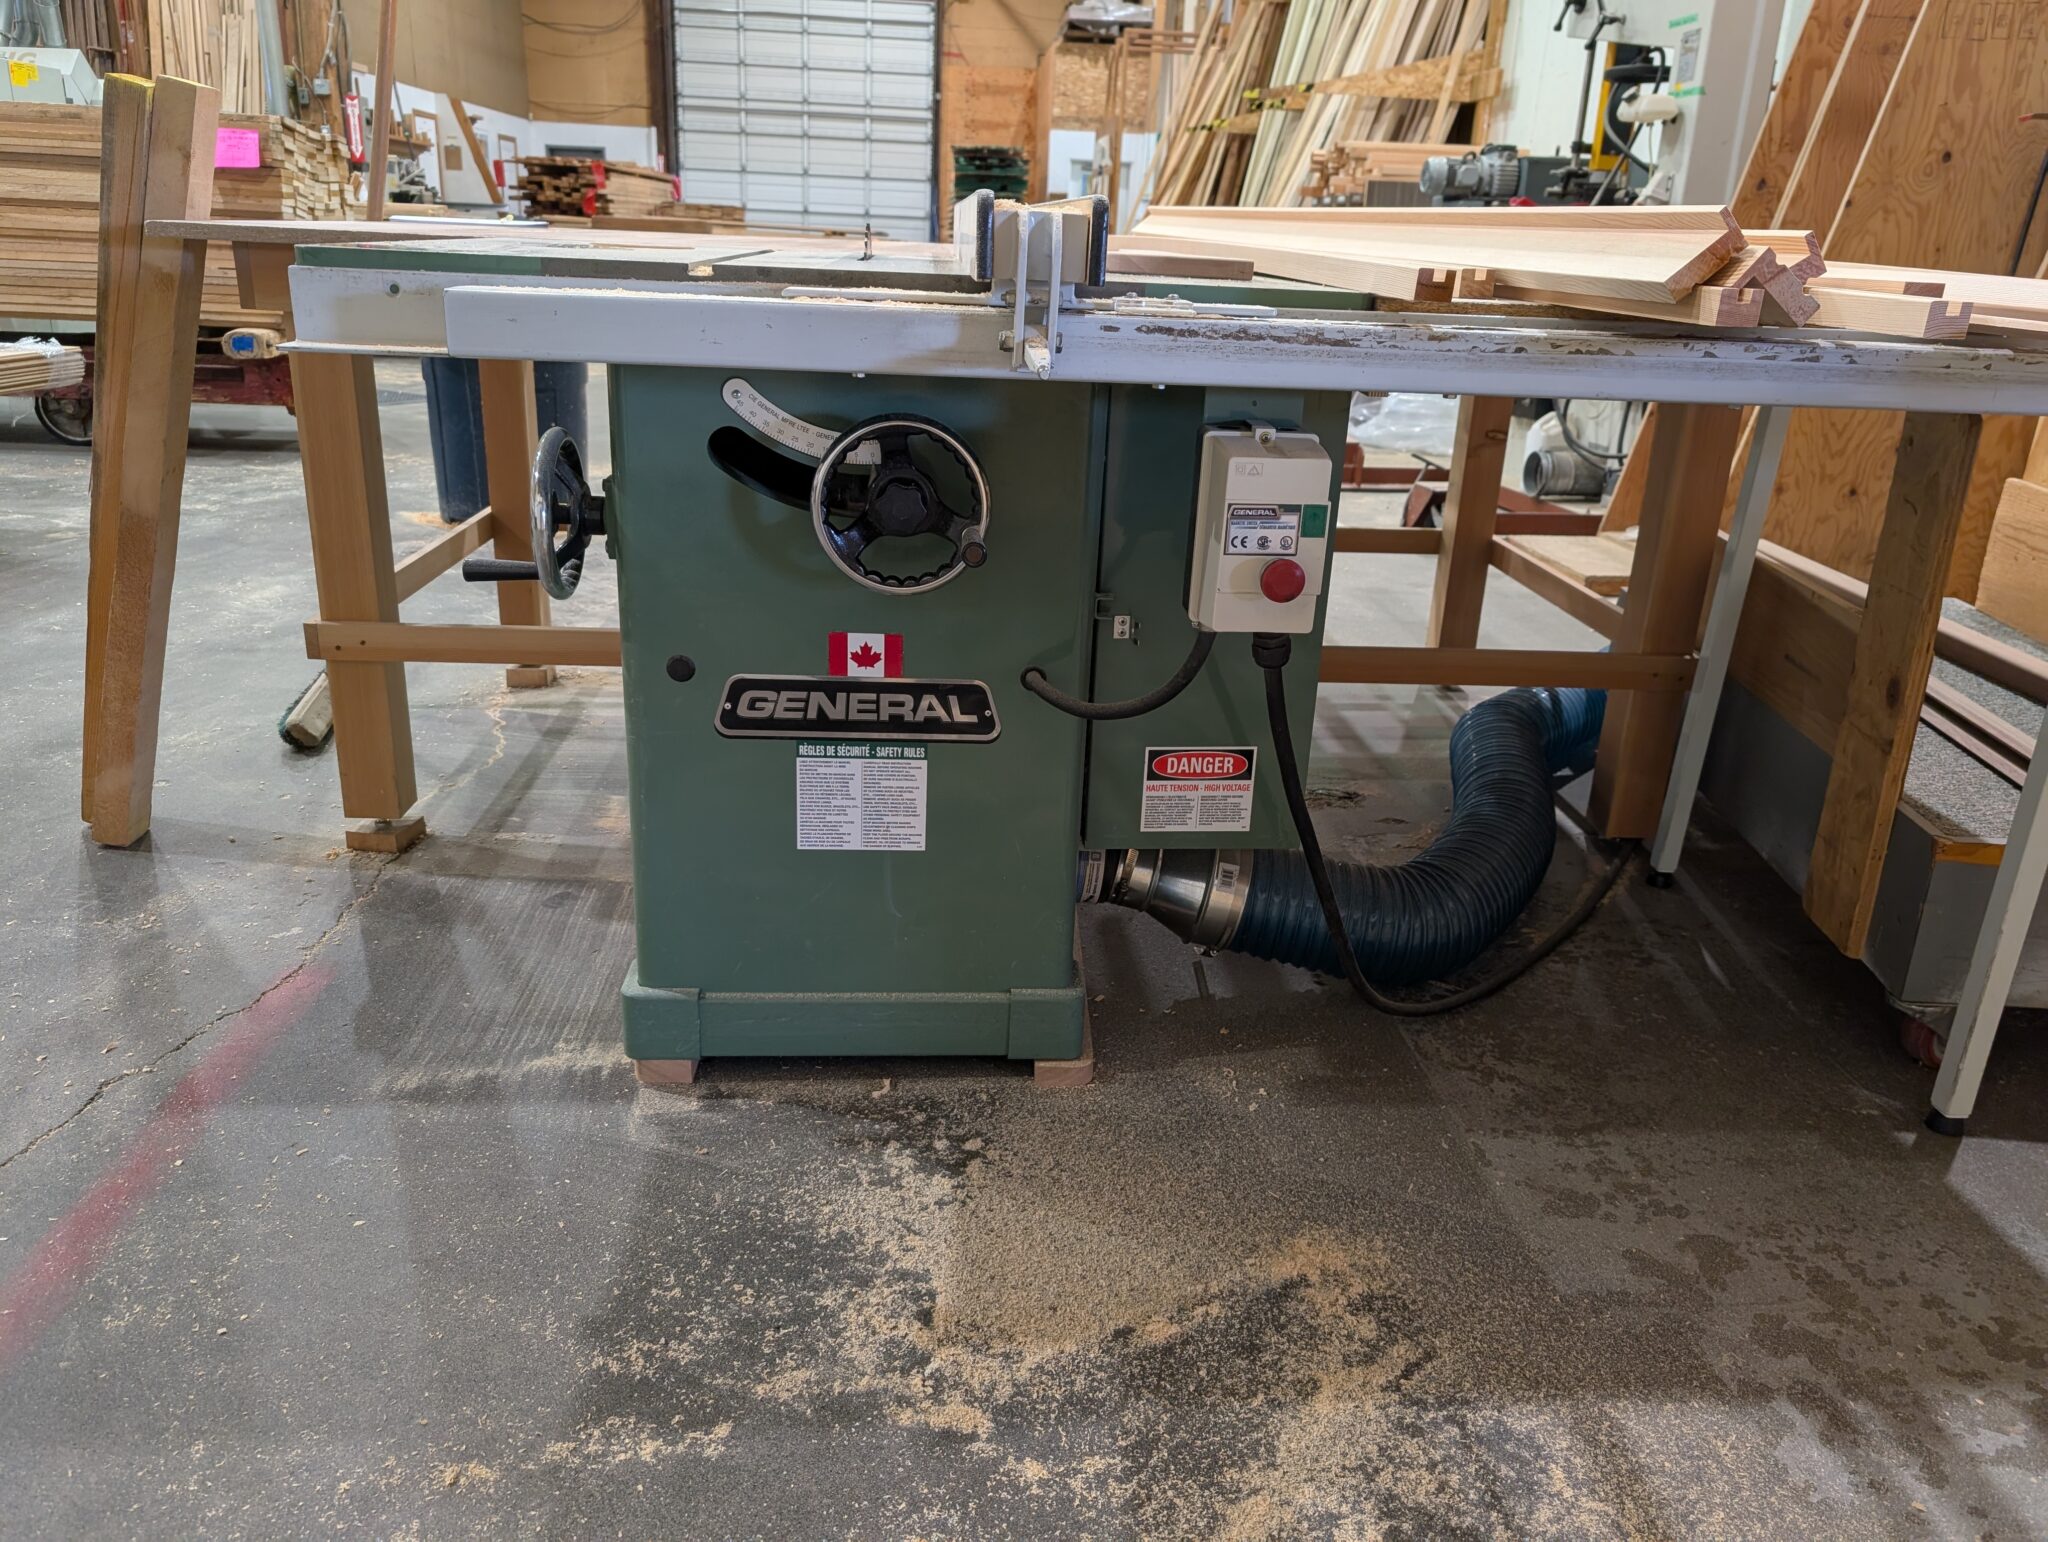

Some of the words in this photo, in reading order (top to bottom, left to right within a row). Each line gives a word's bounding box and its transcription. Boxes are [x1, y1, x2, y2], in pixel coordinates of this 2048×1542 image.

[757, 400, 780, 420] GENERAL
[750, 410, 757, 418] 40
[762, 419, 770, 428] 35
[791, 435, 799, 443] 25
[806, 441, 815, 449] 20
[736, 690, 978, 723] GENERAL
[799, 742, 825, 756] RÈGLES
[826, 746, 836, 756] DE
[837, 743, 870, 757] SÉCURITÉ
[876, 747, 902, 758] SAFETY
[903, 747, 925, 758] RULES
[1167, 757, 1234, 774] DANGER
[1146, 784, 1168, 792] HAUTE
[1170, 784, 1199, 792] TENSION
[1204, 784, 1221, 792] HIGH
[1222, 784, 1251, 792] VOLTAGE
